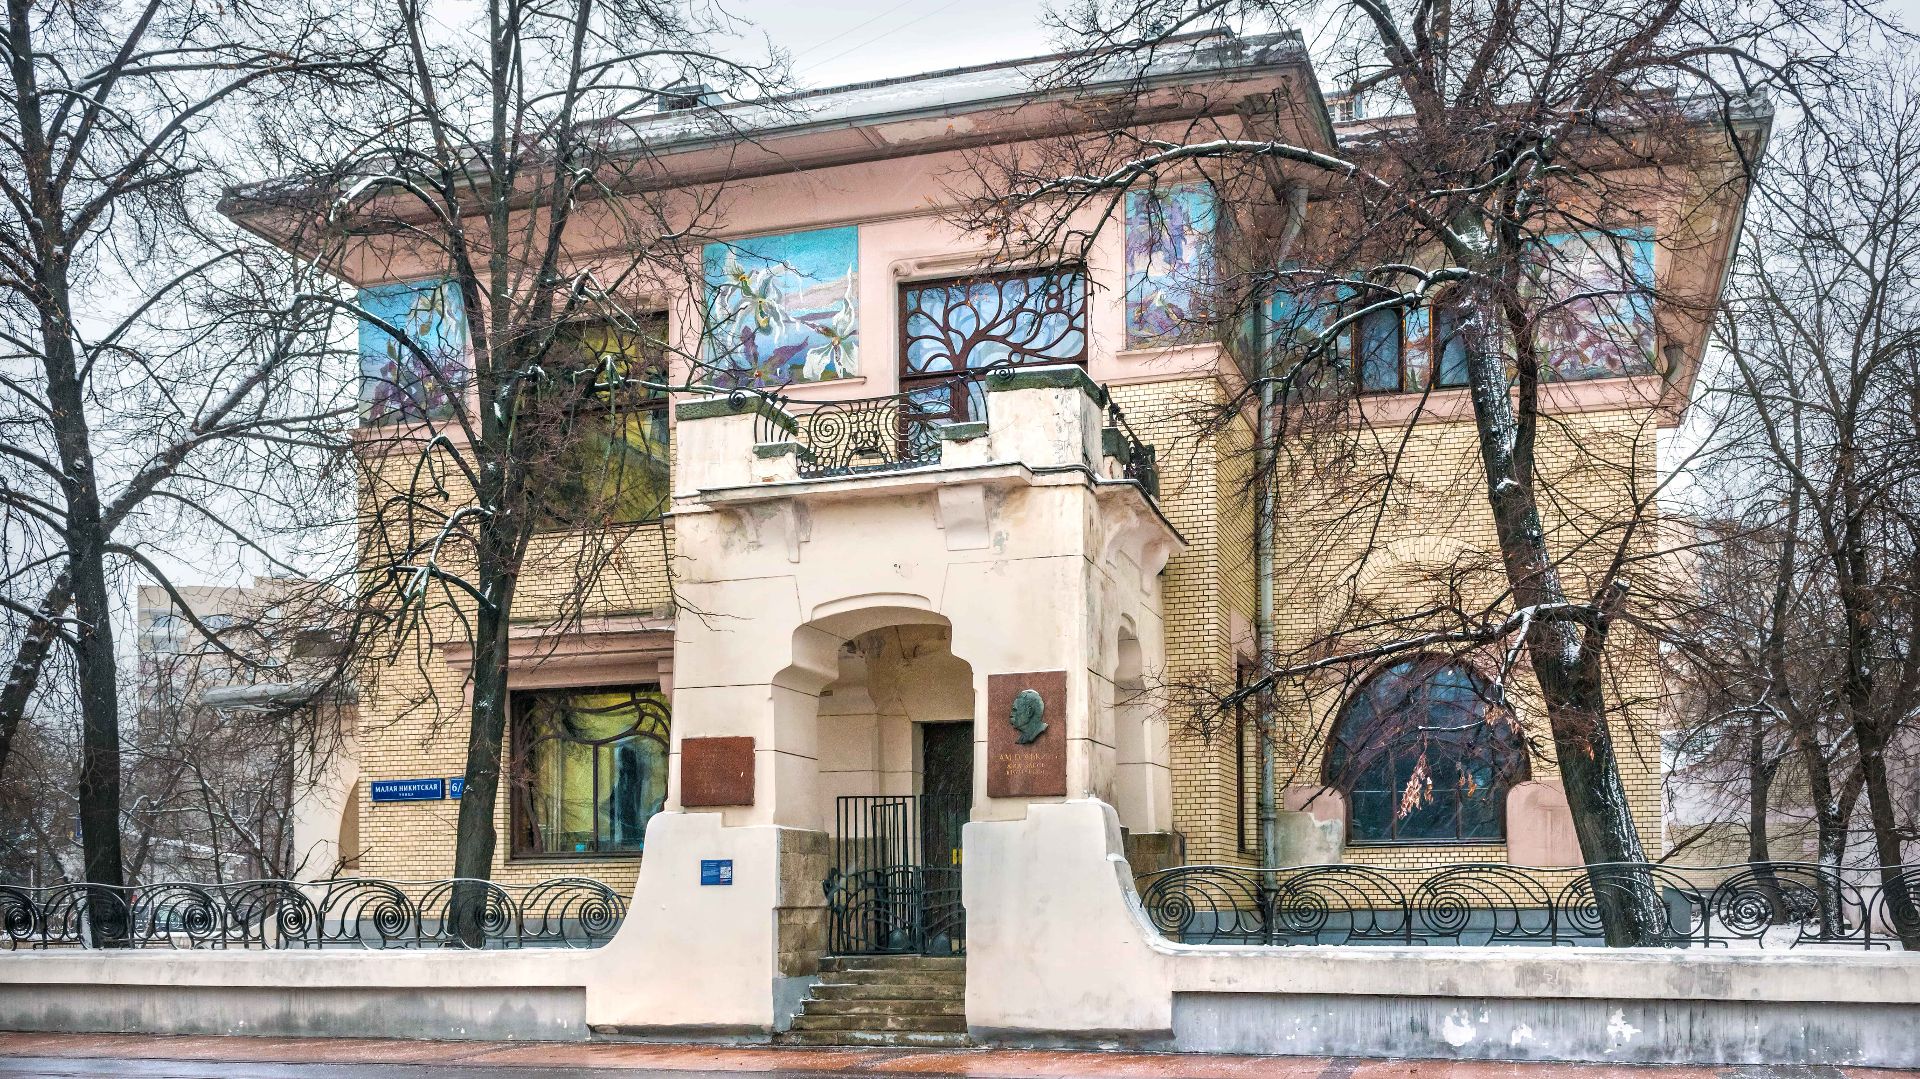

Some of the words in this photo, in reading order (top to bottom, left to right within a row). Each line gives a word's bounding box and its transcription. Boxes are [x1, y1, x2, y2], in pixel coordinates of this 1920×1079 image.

[375, 785, 397, 793] МАЛАЯ
[399, 783, 438, 792] НИКИТСКАЯ
[451, 782, 463, 792] 6/
